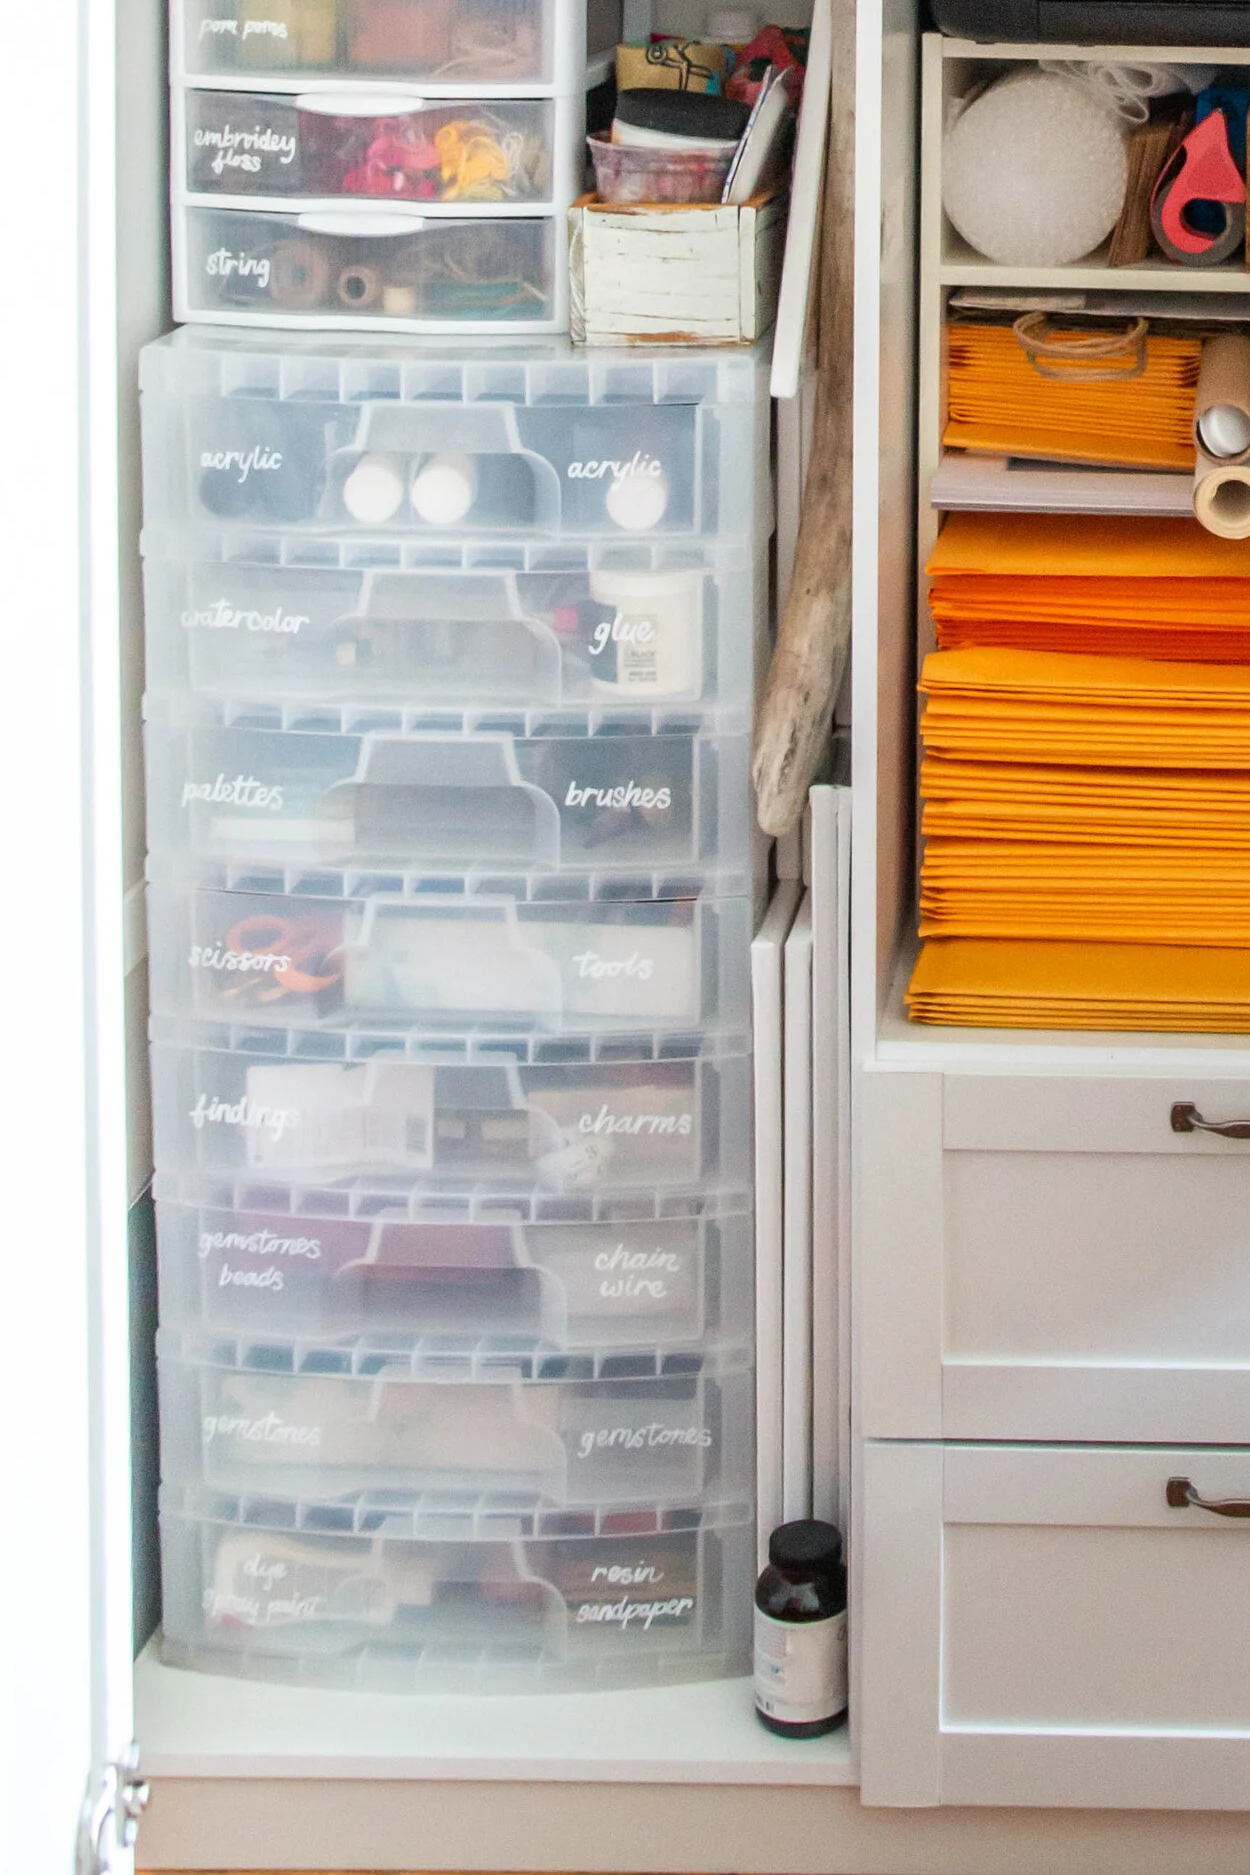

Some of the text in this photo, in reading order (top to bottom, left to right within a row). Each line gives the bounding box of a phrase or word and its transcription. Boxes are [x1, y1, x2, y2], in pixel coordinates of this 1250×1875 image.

[206, 248, 270, 288] string
[200, 445, 282, 482] acrylic
[567, 450, 663, 494] acrylic
[180, 597, 310, 634] watercolor
[588, 612, 655, 655] glue
[181, 775, 283, 809] palettes
[565, 781, 672, 809] brushes
[188, 941, 291, 973] scissors
[572, 951, 654, 981] tools
[578, 1103, 692, 1135] charms
[198, 1229, 321, 1259] gemstones
[594, 1242, 680, 1272] chain
[219, 1262, 284, 1291] beads
[600, 1273, 668, 1299] wire
[577, 1422, 712, 1459] gemstones
[590, 1560, 664, 1585] resin
[576, 1594, 694, 1630] sandpaper
